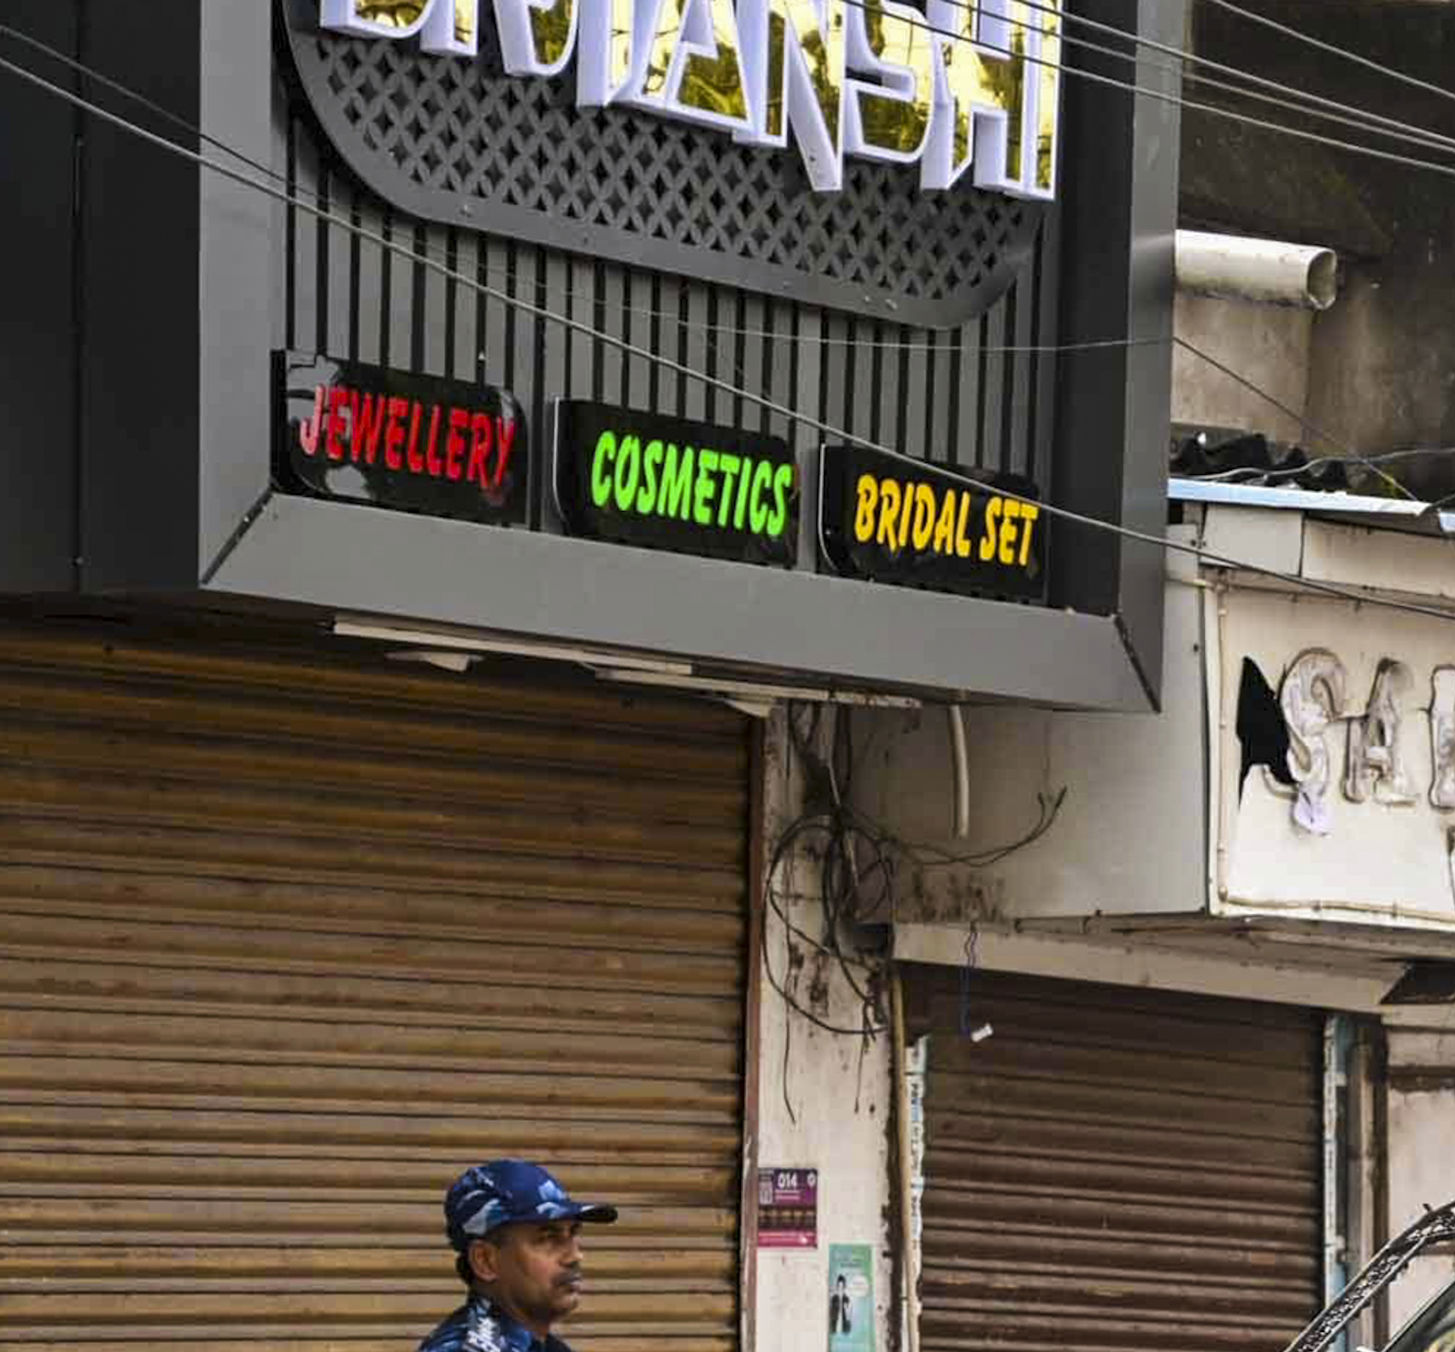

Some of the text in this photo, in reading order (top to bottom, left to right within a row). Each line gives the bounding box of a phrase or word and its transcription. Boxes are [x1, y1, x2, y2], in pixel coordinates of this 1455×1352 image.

[300, 384, 515, 490] JEWELLERY
[591, 430, 791, 538] COSMETICS
[855, 474, 1038, 568] BRIDAL SET
